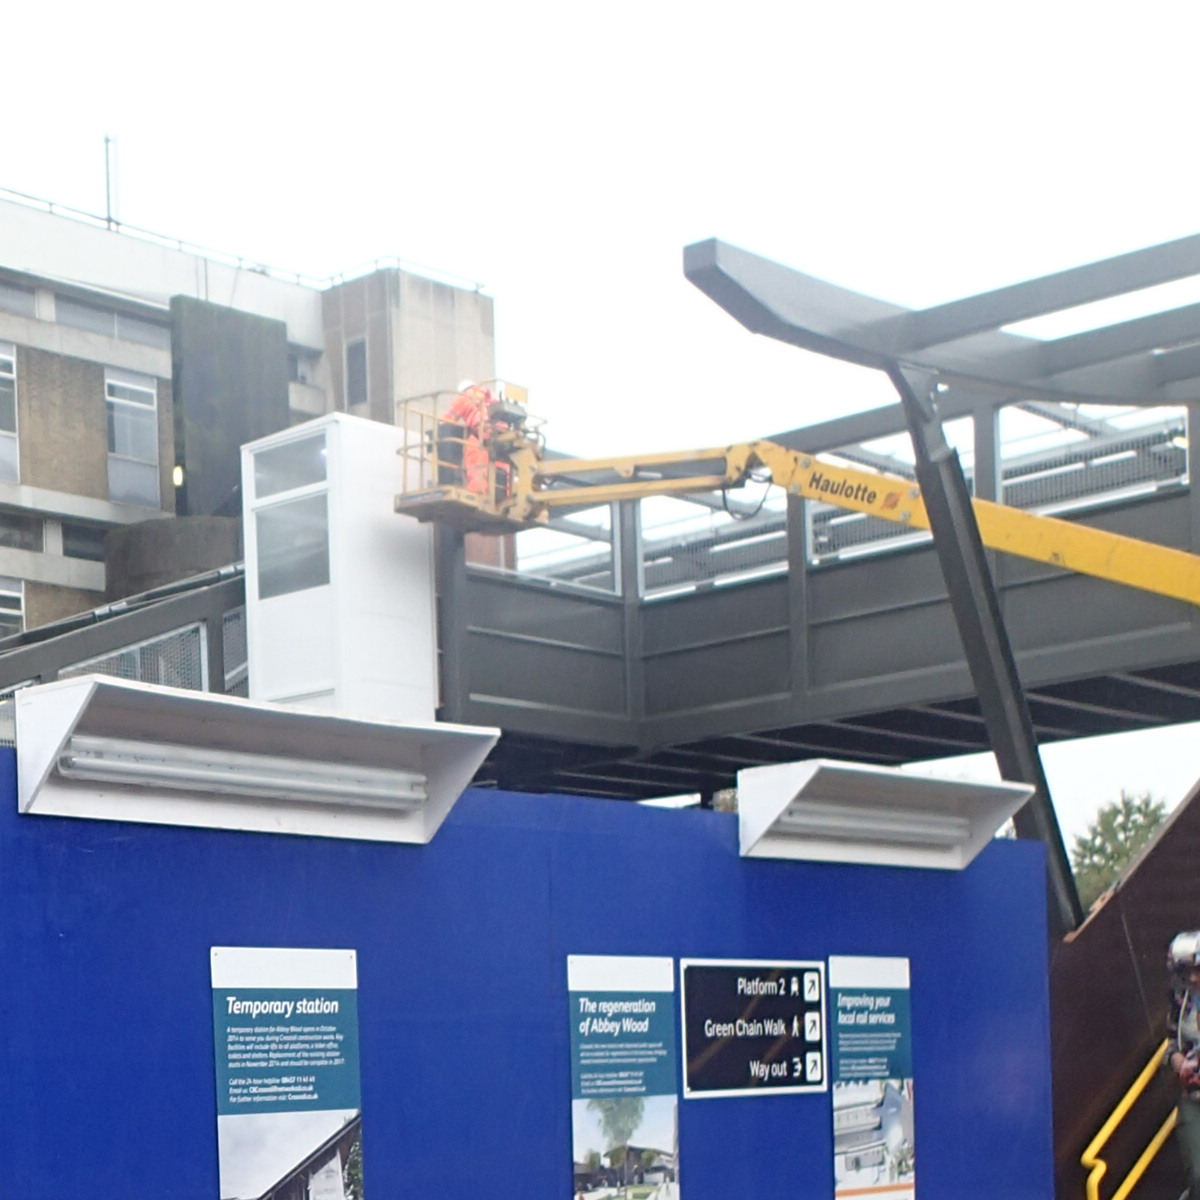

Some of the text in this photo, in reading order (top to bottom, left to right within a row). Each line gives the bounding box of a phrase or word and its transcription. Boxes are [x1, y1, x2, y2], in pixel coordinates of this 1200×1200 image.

[809, 472, 877, 504] Haulotte
[737, 977, 786, 995] Platform 2
[226, 996, 339, 1018] Temporary station
[579, 997, 656, 1017] The regeneration
[579, 1017, 649, 1037] of Abbey Wood
[704, 1018, 786, 1037] Green Chain Walk
[750, 1060, 787, 1081] Way out
